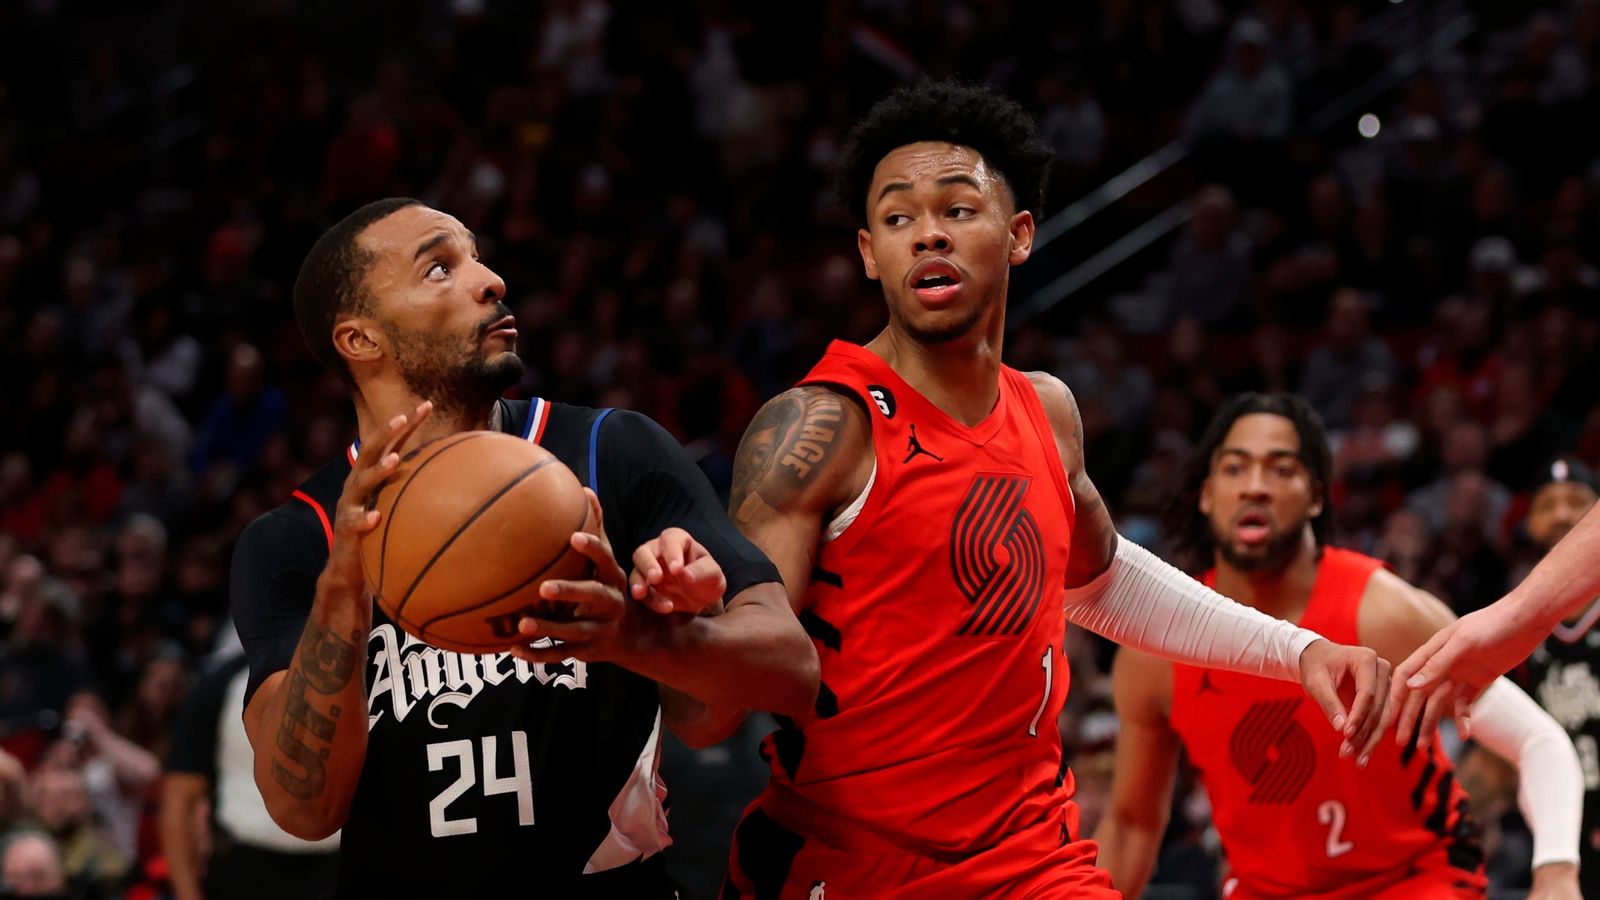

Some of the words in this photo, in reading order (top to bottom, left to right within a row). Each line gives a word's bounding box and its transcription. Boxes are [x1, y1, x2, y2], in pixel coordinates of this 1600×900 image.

[1028, 645, 1053, 737] 1
[426, 730, 535, 838] 24
[1317, 800, 1354, 858] 2
